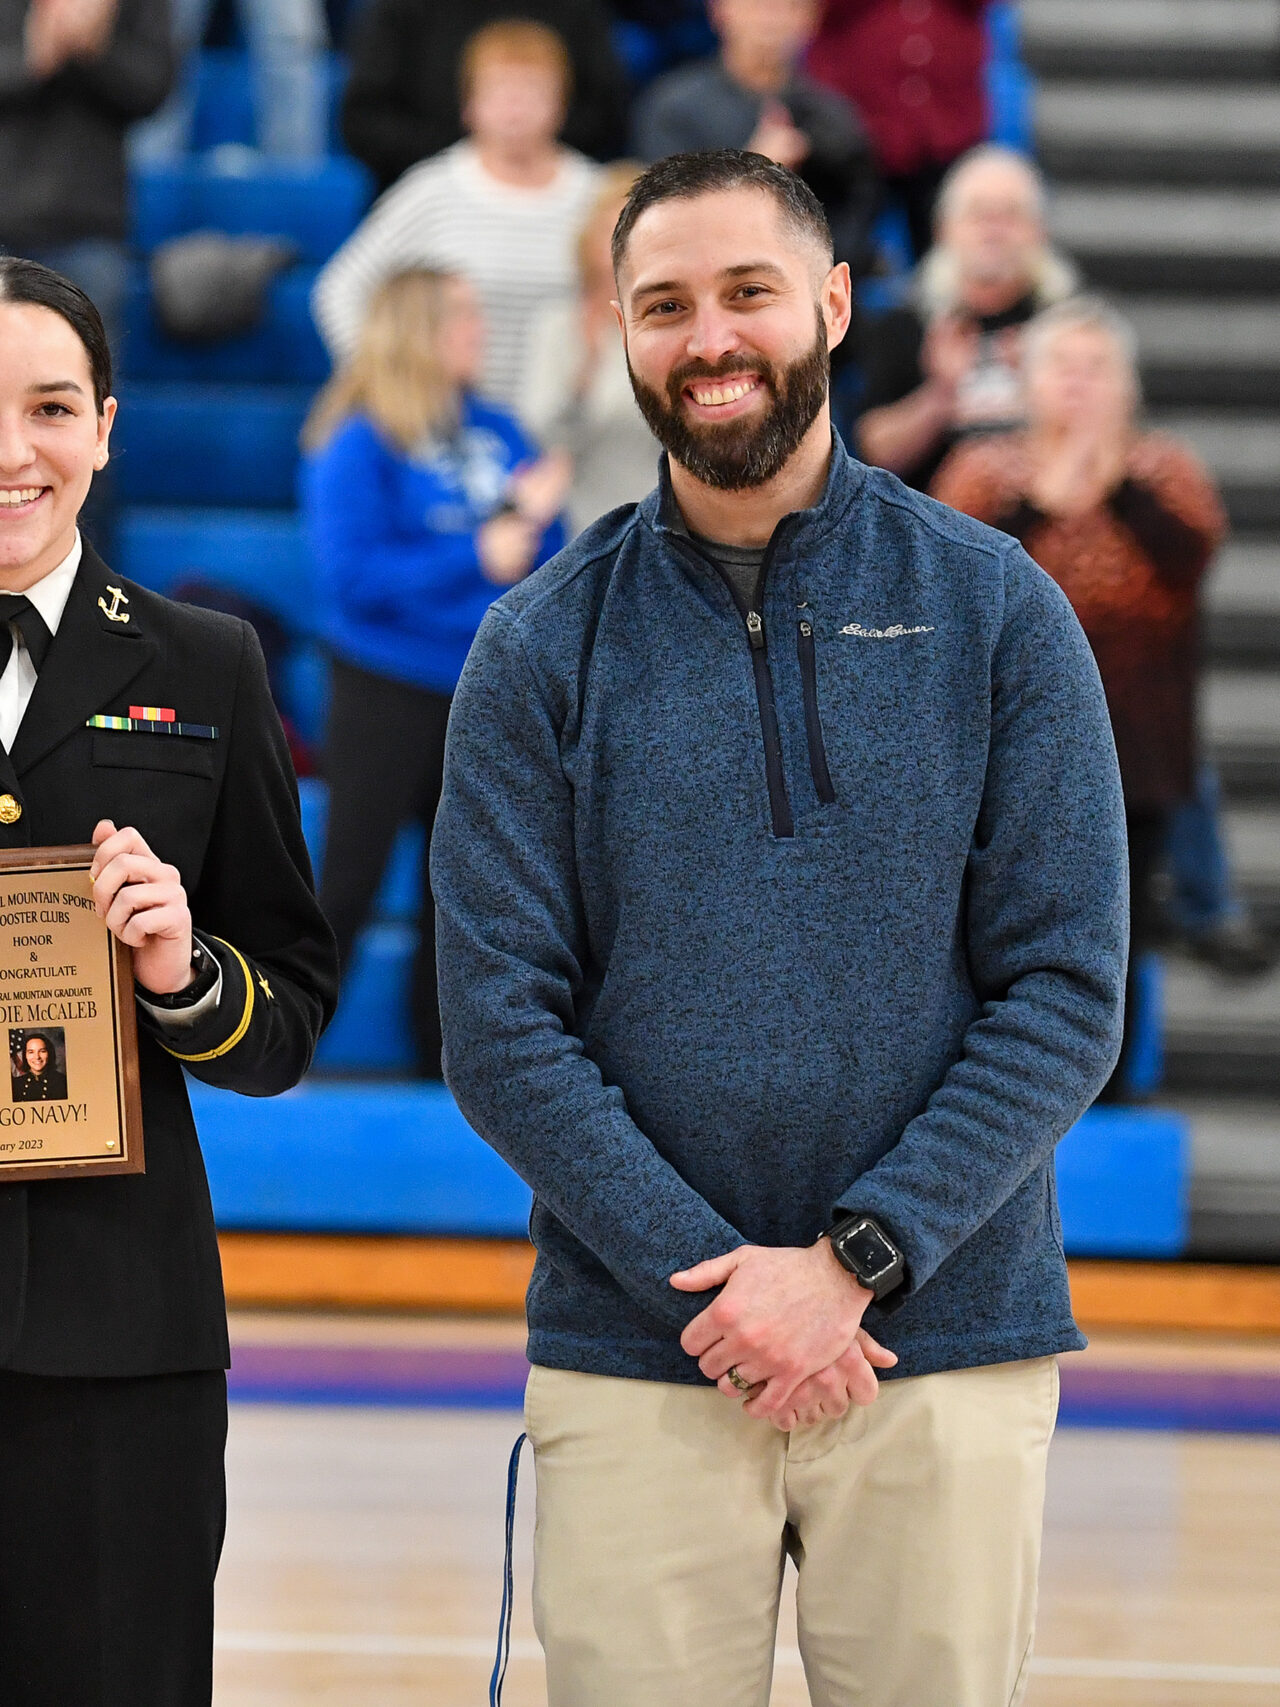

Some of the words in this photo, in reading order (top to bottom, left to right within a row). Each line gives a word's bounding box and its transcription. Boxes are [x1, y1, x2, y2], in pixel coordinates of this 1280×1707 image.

[7, 891, 60, 907] MOUNTAIN
[40, 911, 70, 924] CLUBS
[13, 935, 53, 947] HONOR
[29, 952, 38, 962] &
[13, 989, 53, 1000] MOUNTAIN
[54, 987, 93, 998] GRADUATE
[28, 1001, 97, 1022] McCALEB
[31, 1103, 88, 1125] NAVY!
[18, 1139, 43, 1150] 2023
